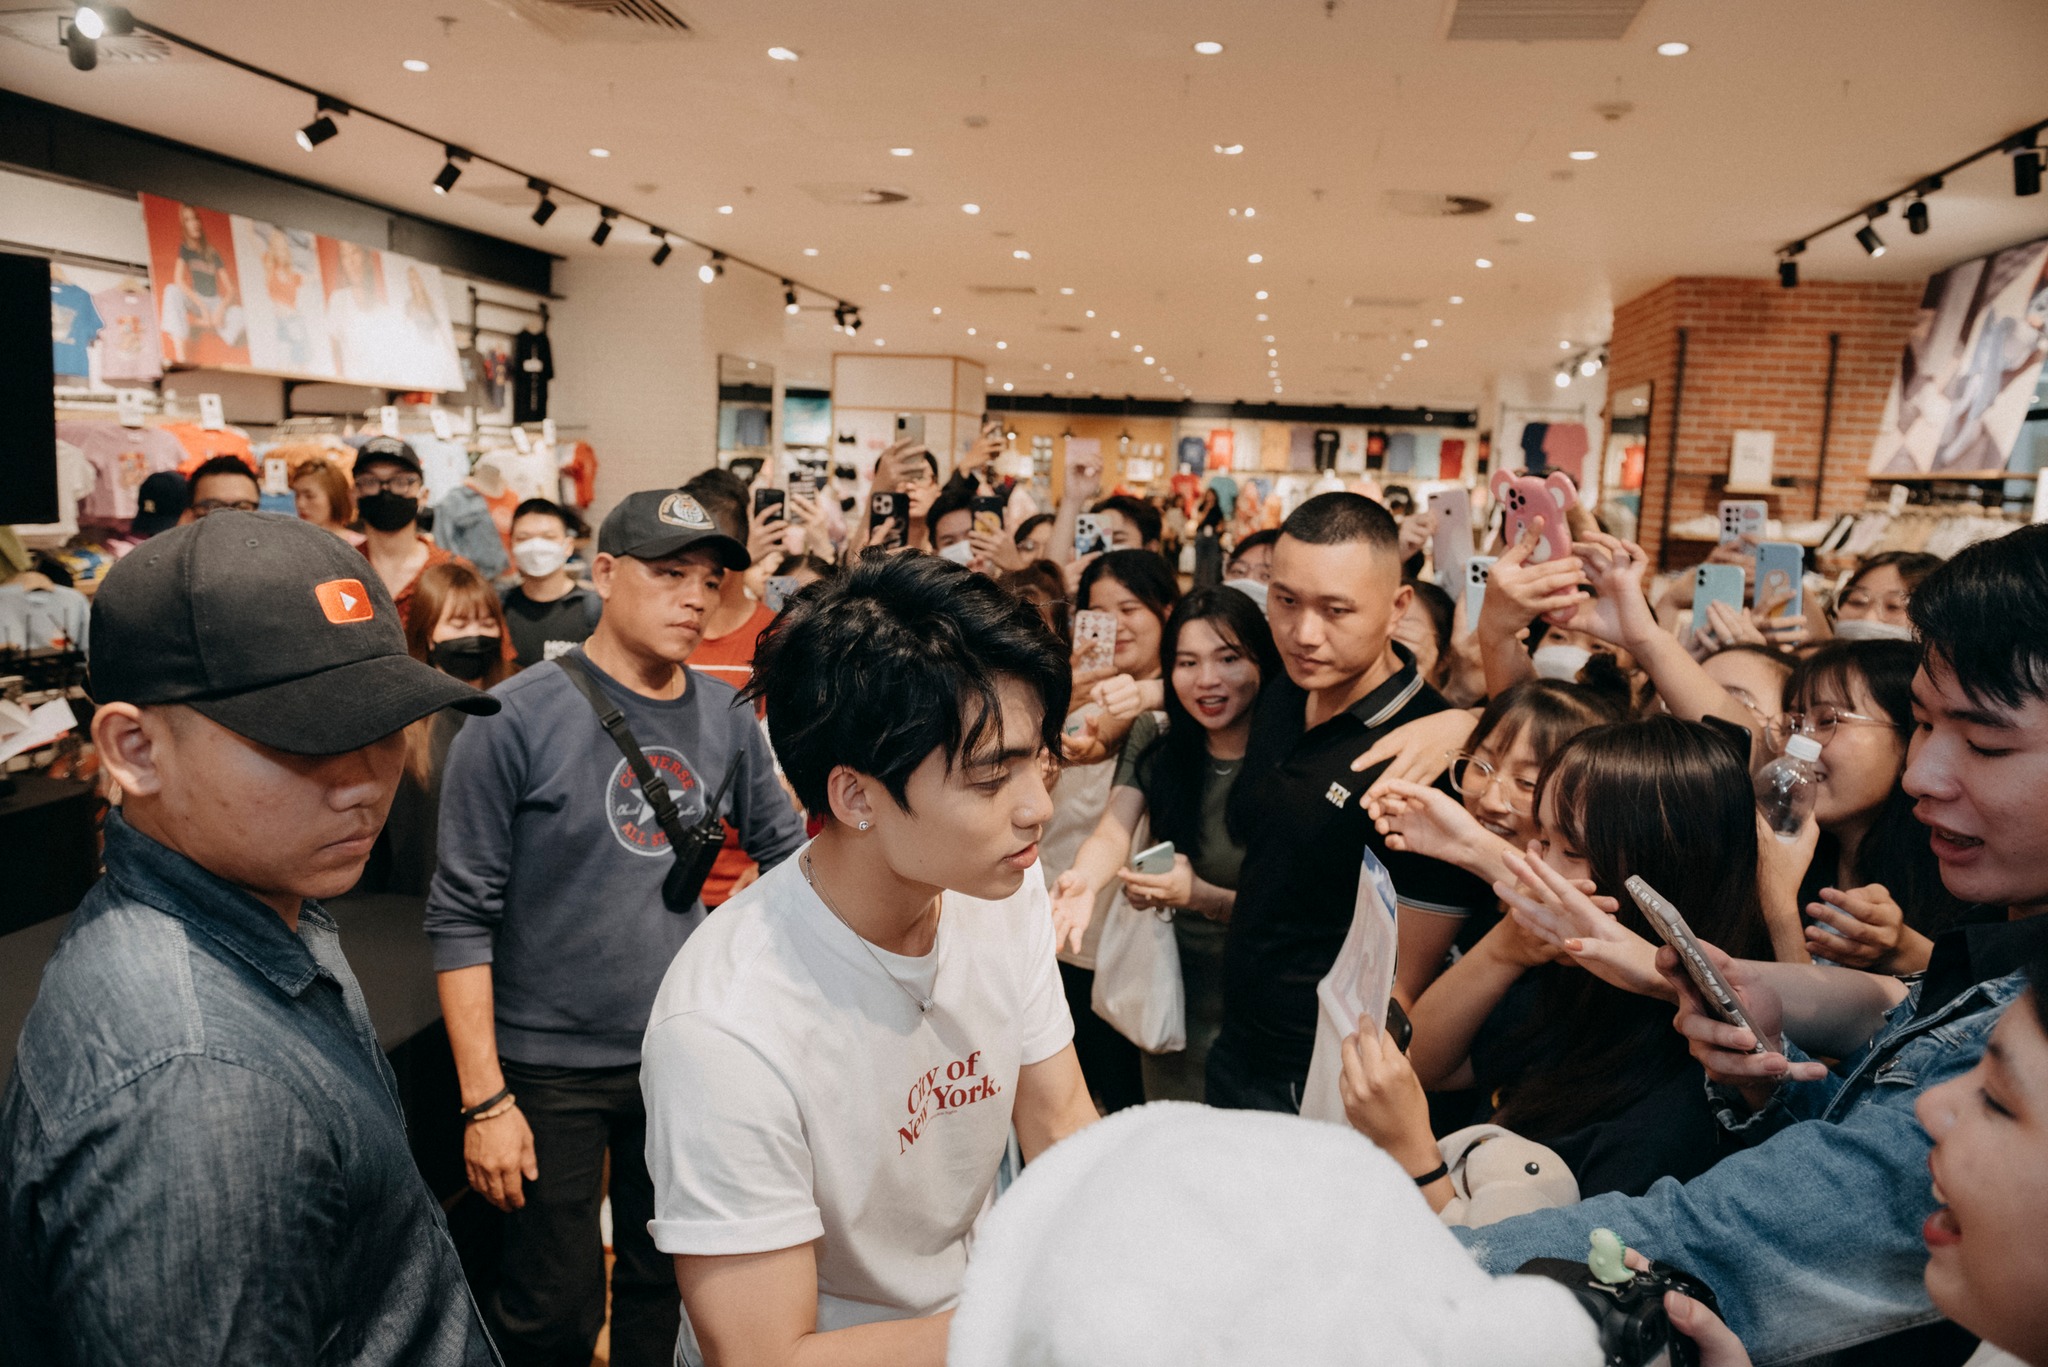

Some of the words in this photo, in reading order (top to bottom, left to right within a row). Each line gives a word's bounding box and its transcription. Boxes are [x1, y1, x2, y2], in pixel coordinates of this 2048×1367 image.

[619, 755, 696, 791] COVERSE
[620, 821, 646, 846] ALL
[946, 1050, 981, 1081] of
[932, 1074, 1001, 1111] York.
